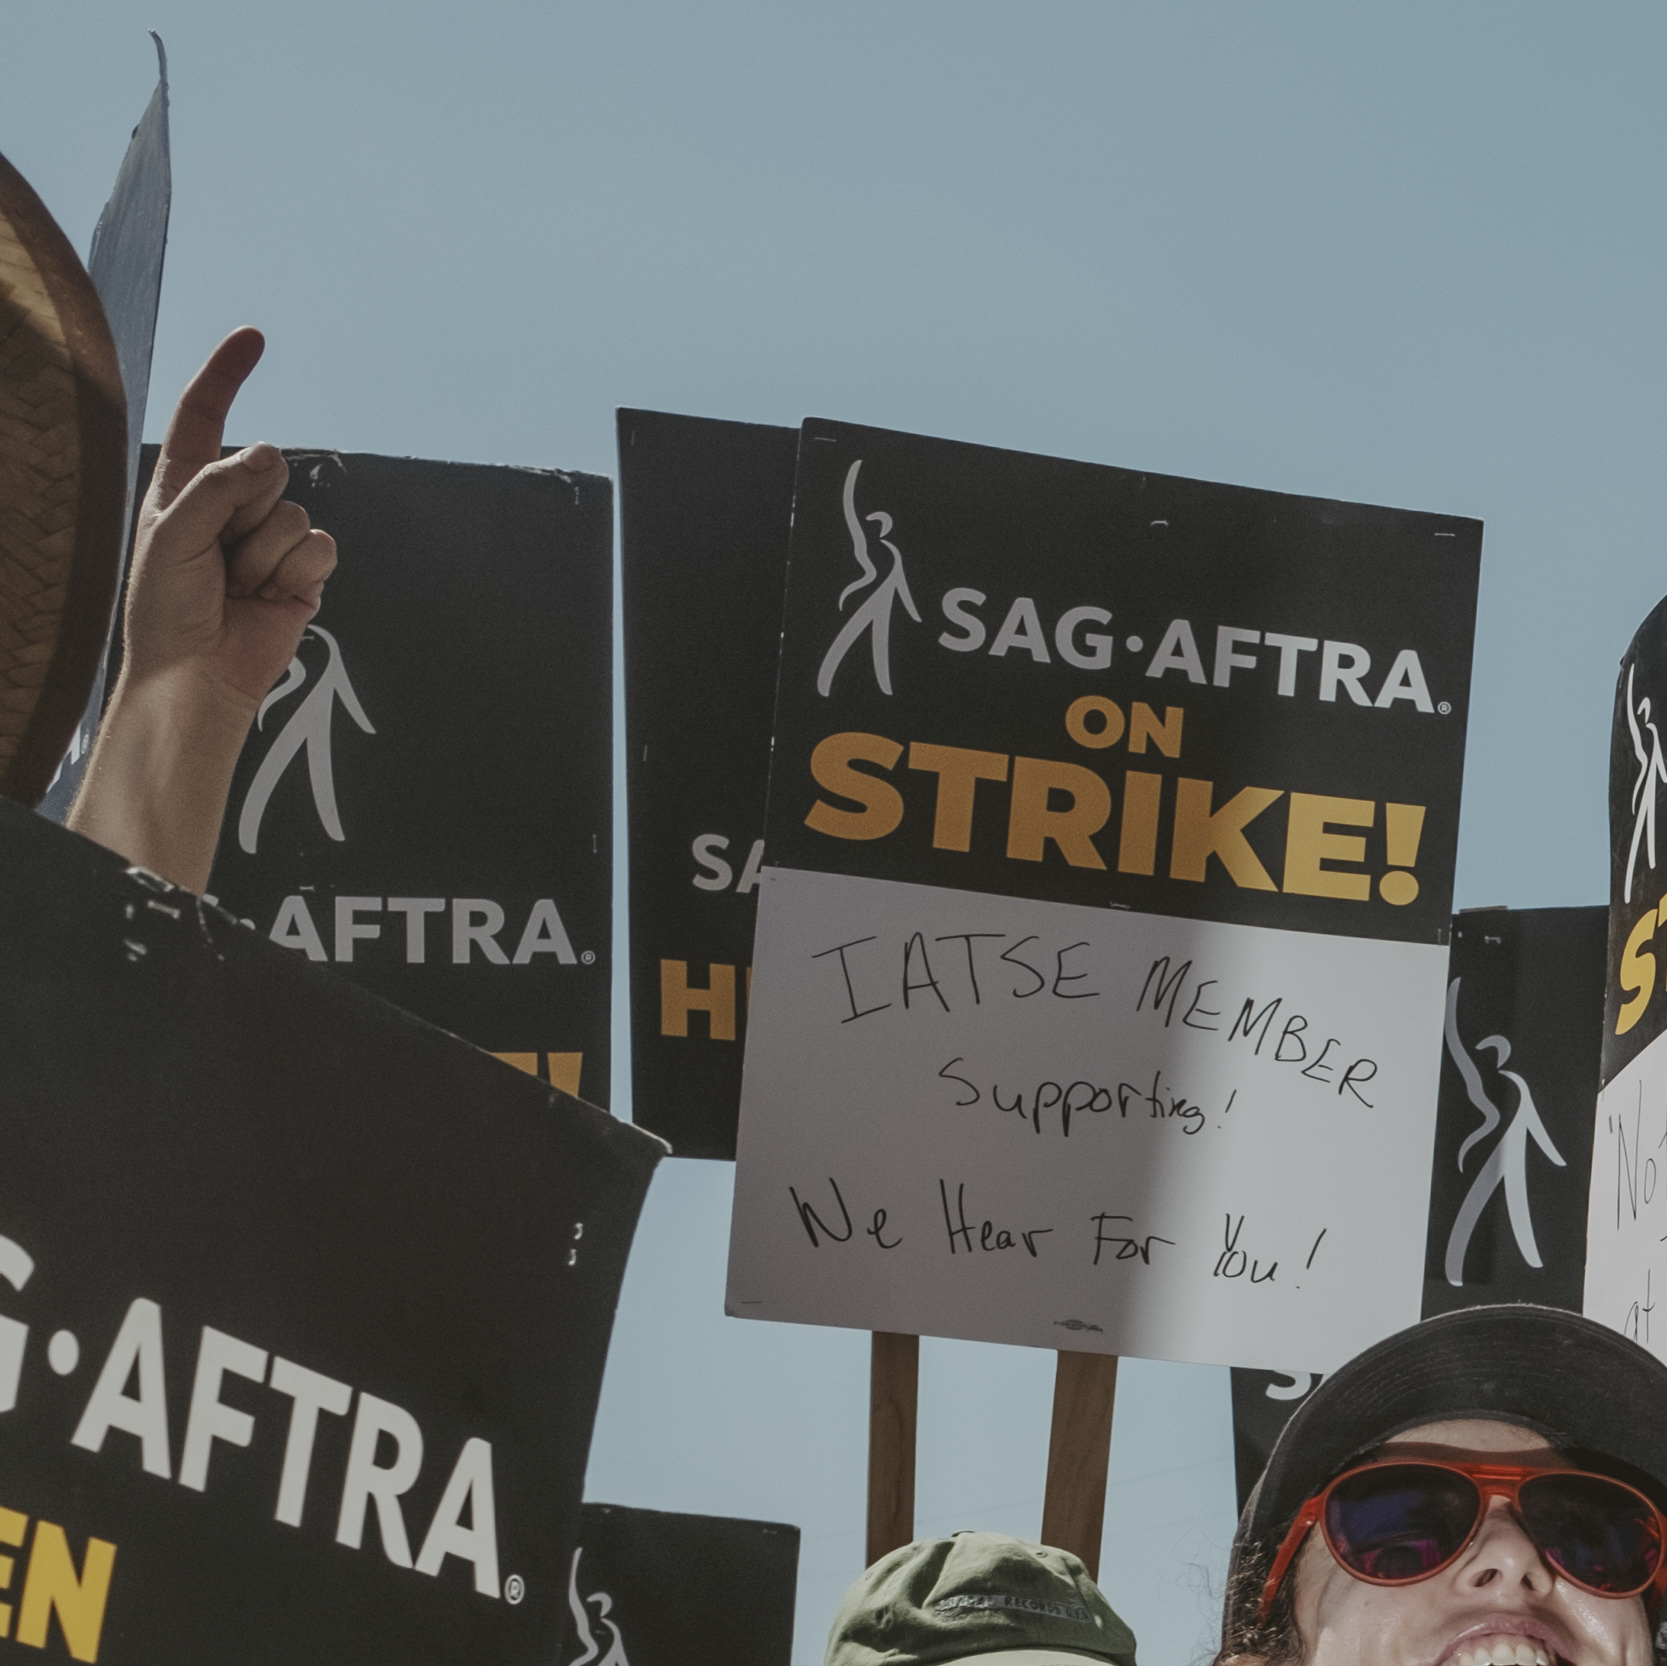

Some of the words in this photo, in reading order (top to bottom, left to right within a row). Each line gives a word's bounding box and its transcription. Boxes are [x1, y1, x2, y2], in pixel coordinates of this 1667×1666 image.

[1065, 695, 1184, 759] ON
[804, 731, 1427, 906] STRIKE!
[811, 932, 1099, 1024] IATSE
[1136, 956, 1378, 1108] MEMBER
[938, 1057, 1237, 1138] Supporting!
[940, 1178, 1054, 1256] Hear
[1090, 1211, 1176, 1266] For
